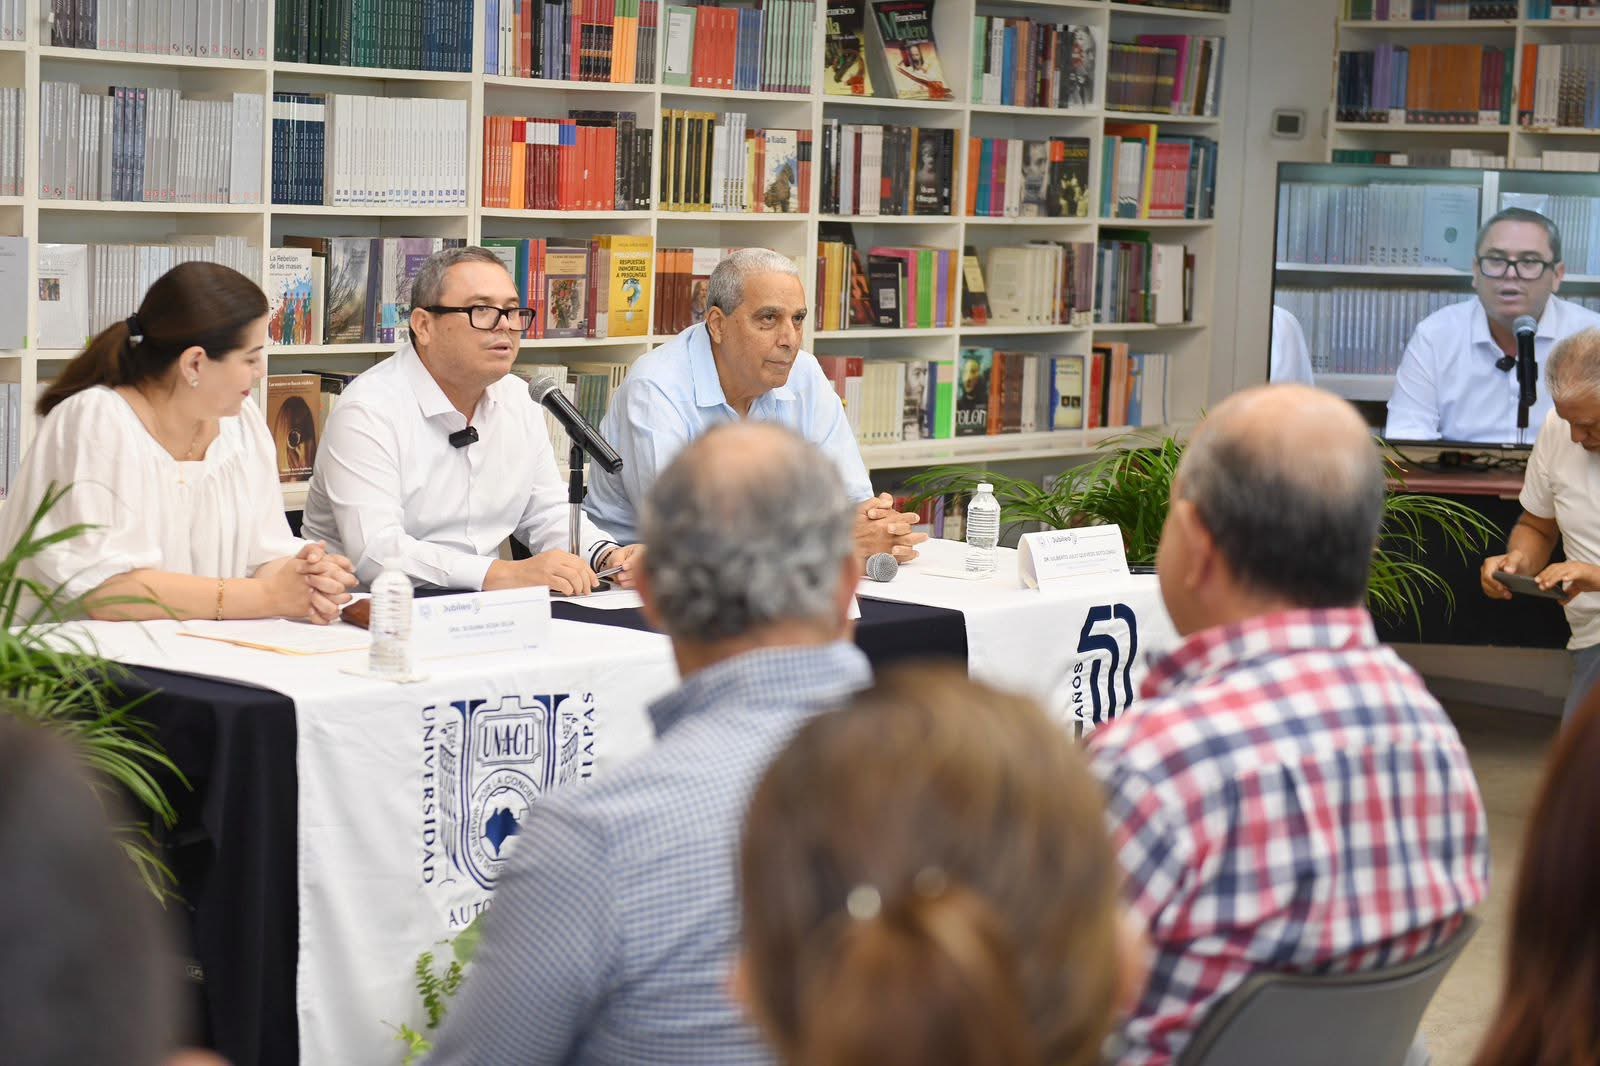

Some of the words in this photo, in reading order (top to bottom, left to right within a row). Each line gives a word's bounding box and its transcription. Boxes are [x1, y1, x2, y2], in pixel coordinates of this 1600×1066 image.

[1072, 661, 1084, 718] AÑOS
[483, 723, 534, 758] UNACH
[422, 705, 436, 884] UNIVERSIDAD
[448, 897, 496, 928] AUTO
